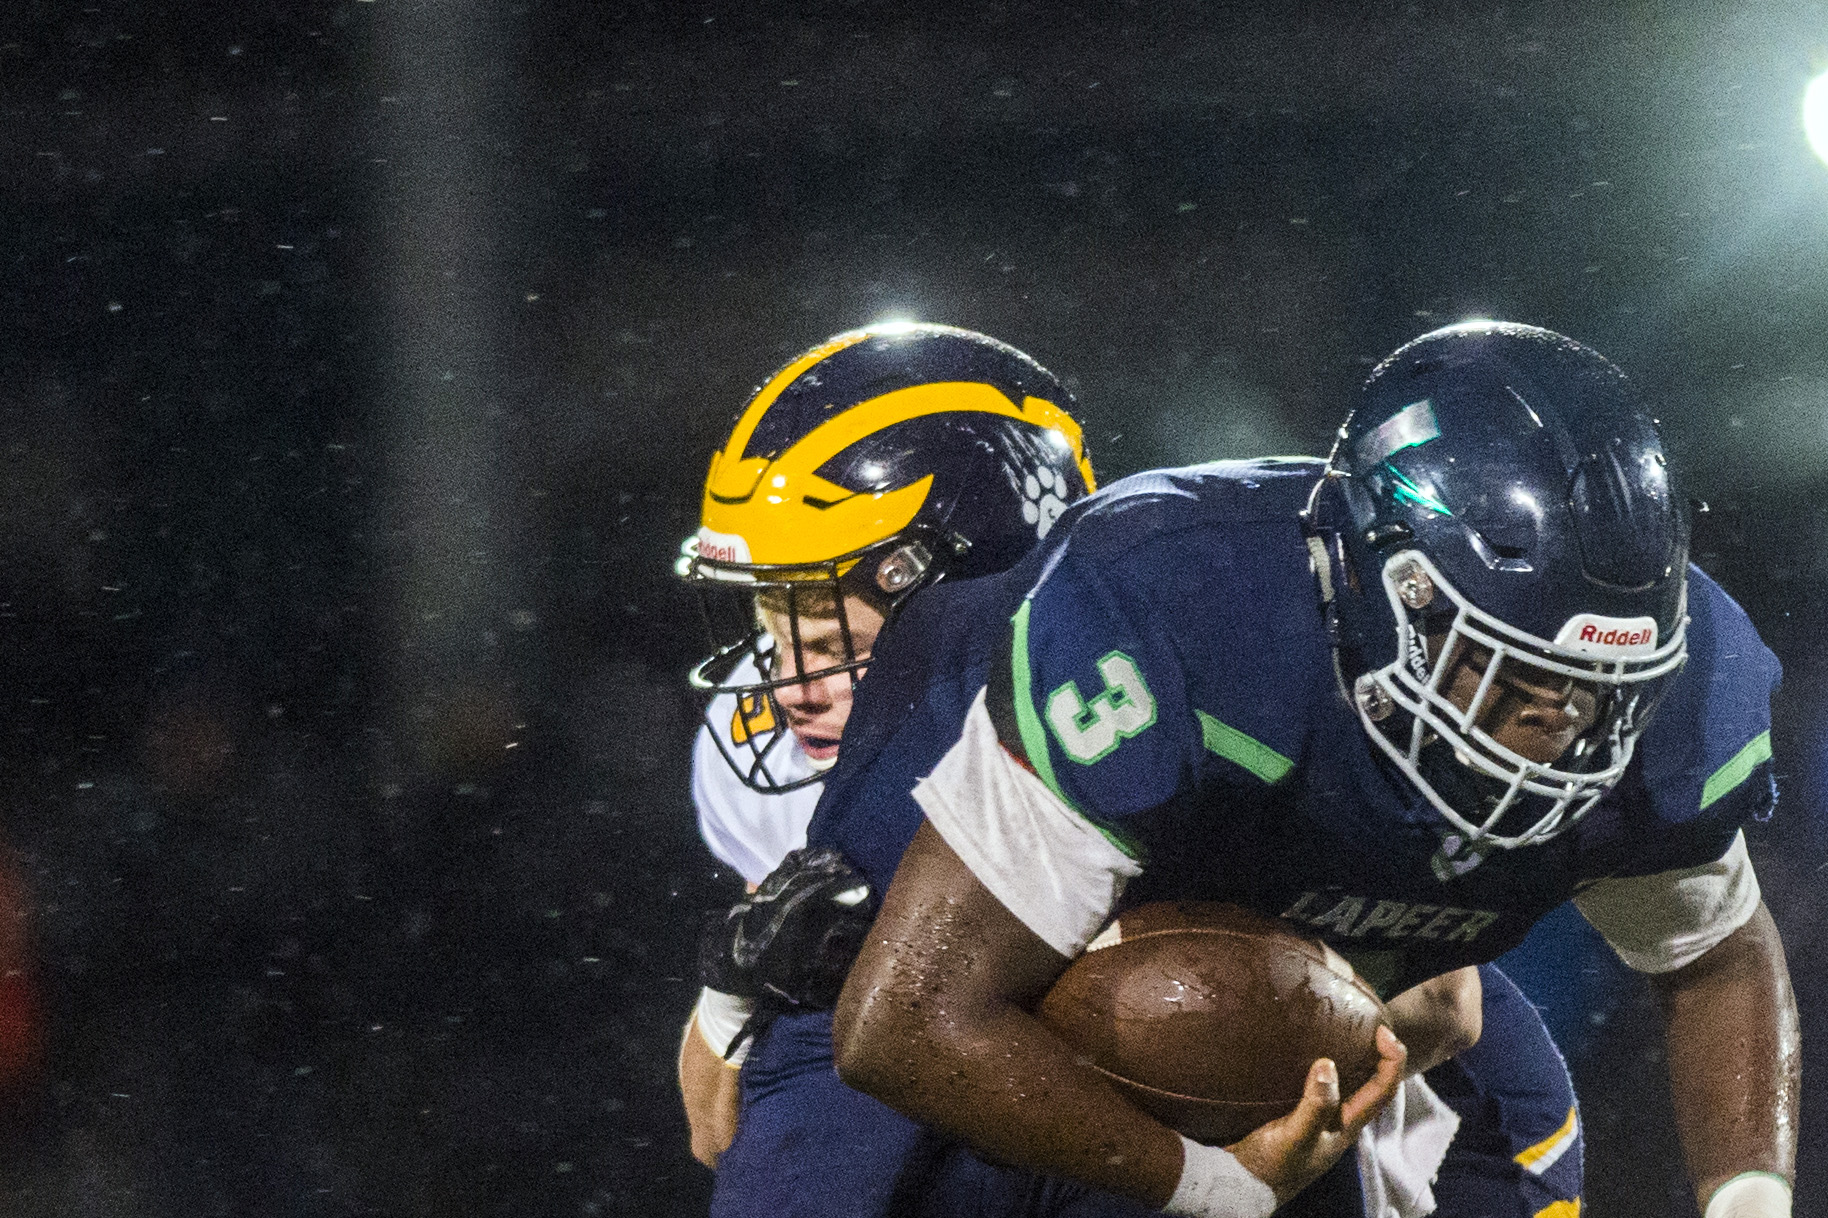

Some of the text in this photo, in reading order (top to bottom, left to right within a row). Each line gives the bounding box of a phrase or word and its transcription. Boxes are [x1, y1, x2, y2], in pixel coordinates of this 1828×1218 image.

[1579, 624, 1652, 646] Riddell
[1044, 650, 1157, 766] 3
[1280, 892, 1498, 942] LAPEER
